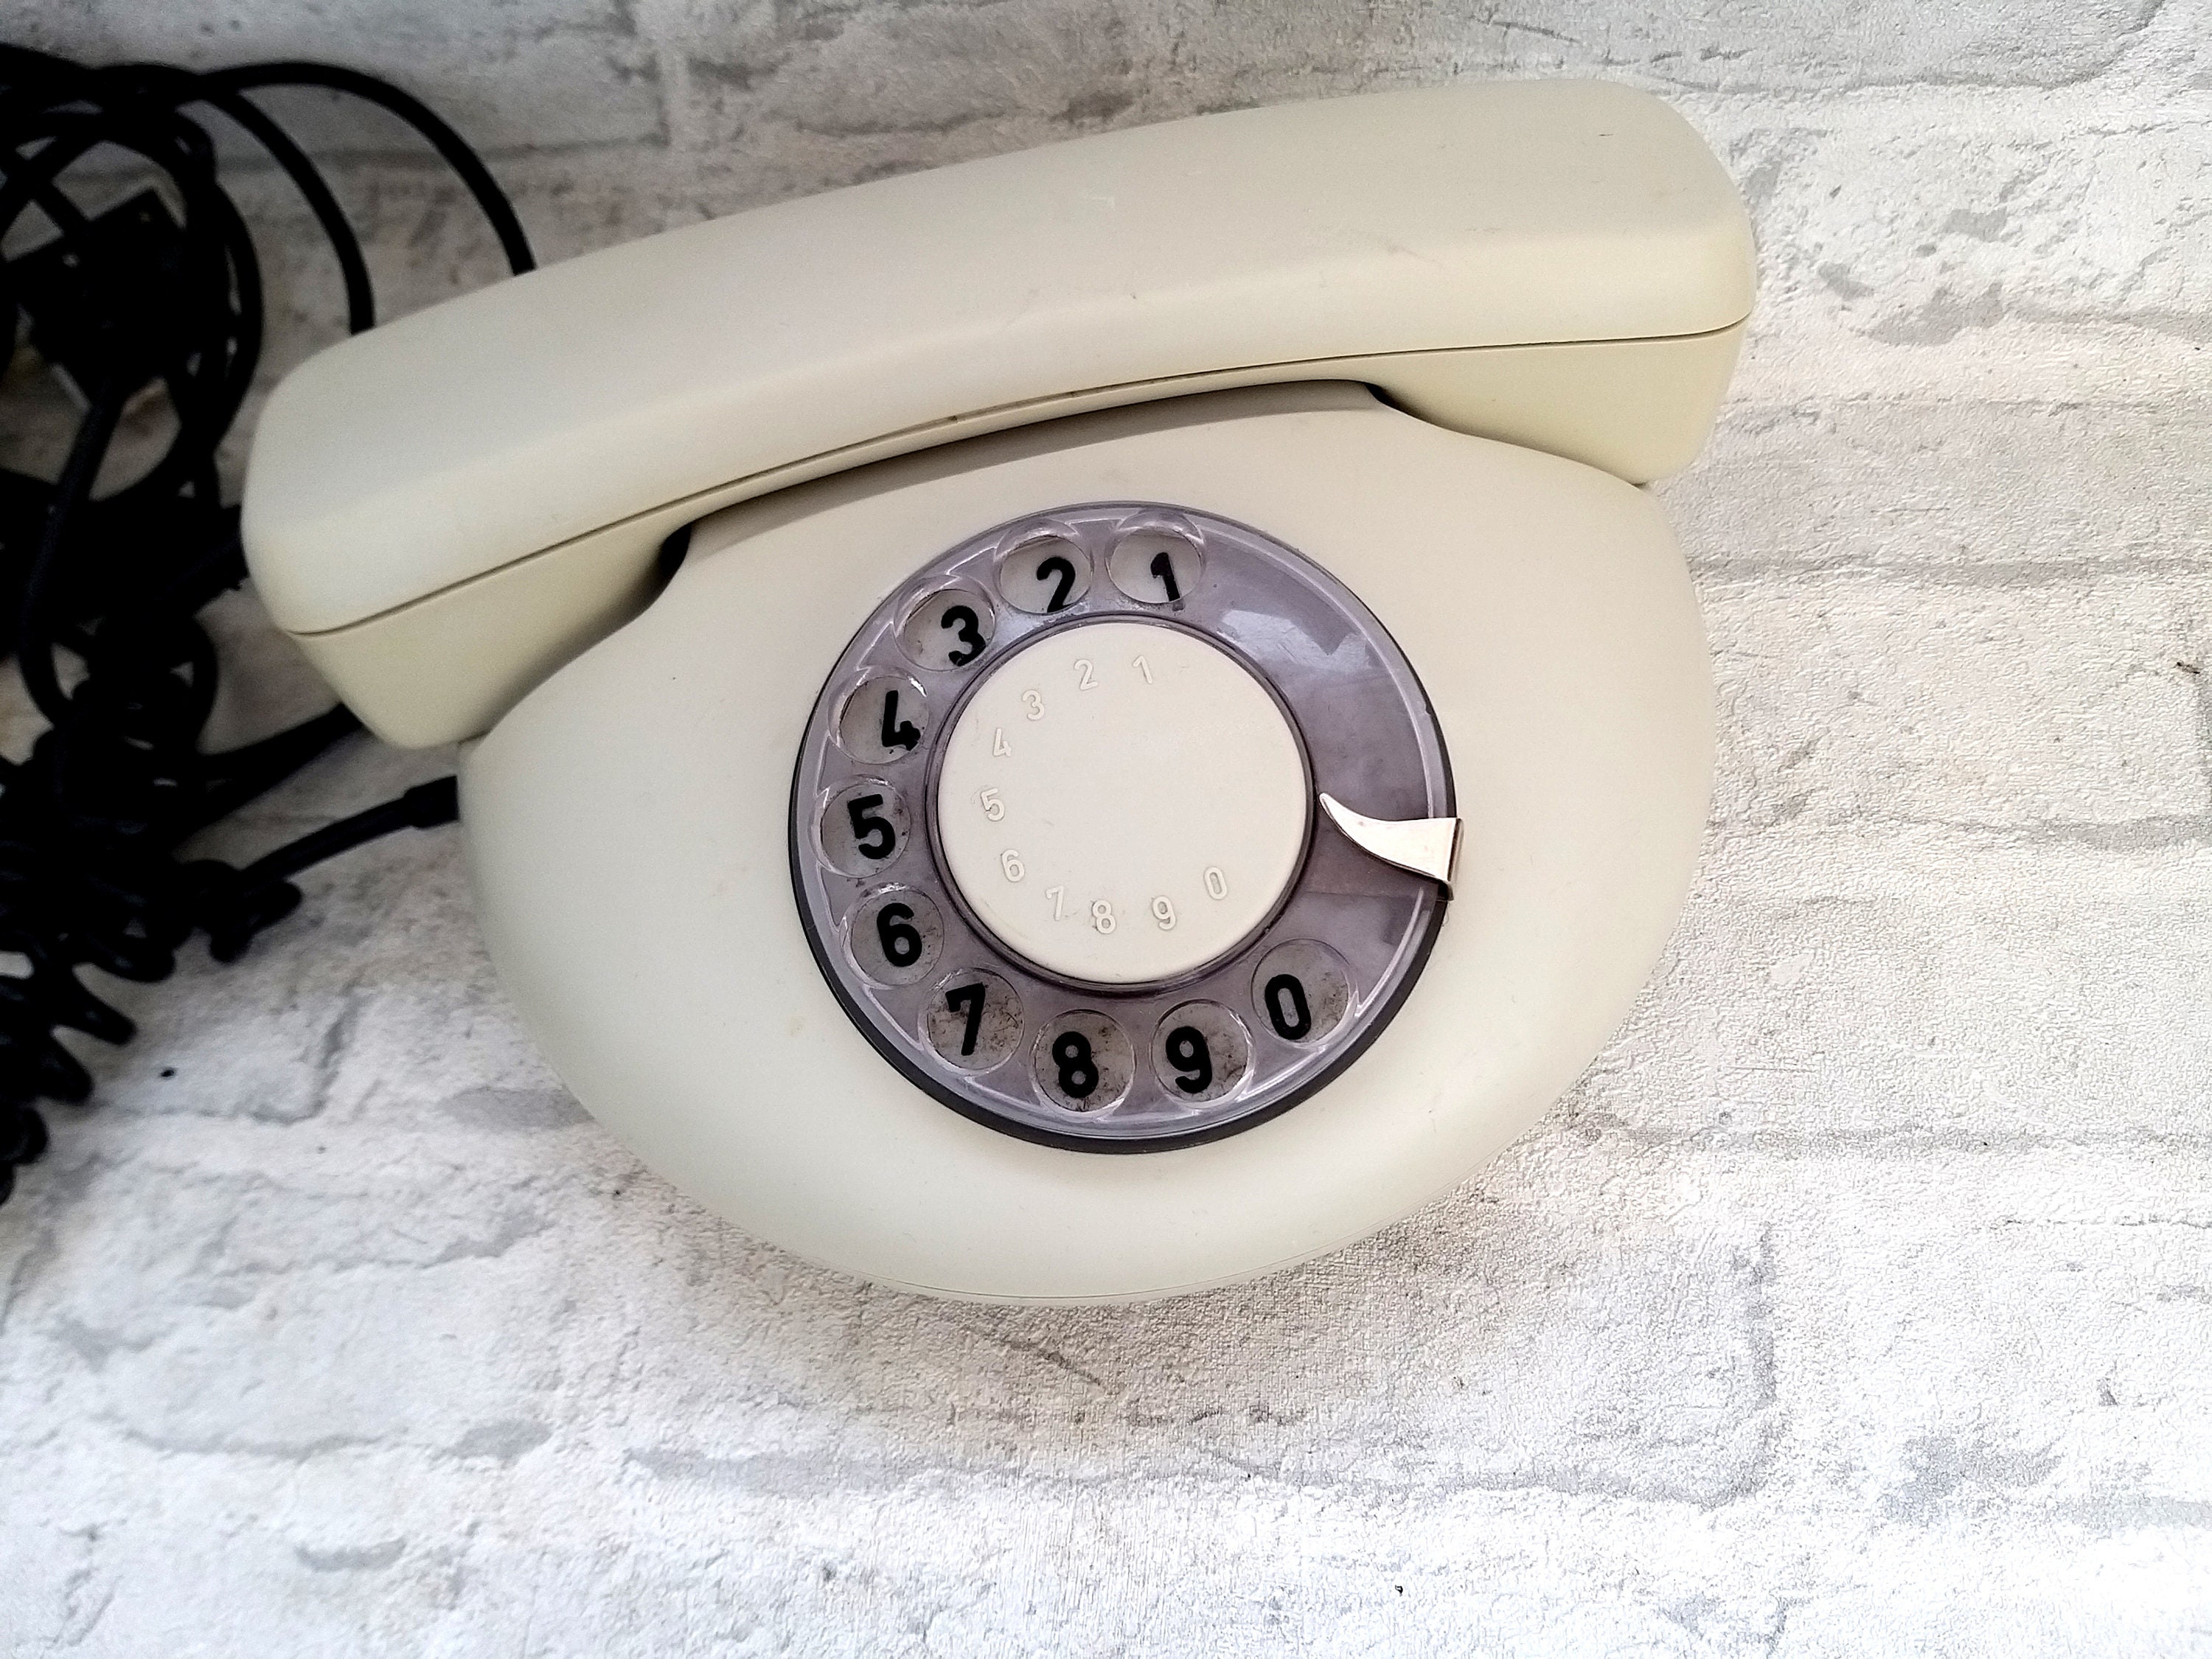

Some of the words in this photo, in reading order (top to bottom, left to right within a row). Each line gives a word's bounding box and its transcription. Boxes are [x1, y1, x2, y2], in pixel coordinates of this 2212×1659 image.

[1037, 557, 1077, 612] 2
[1150, 552, 1185, 610] 1
[941, 605, 987, 667] 3
[1074, 659, 1099, 689] 2
[1133, 656, 1153, 684] 1
[882, 691, 921, 751] 4
[1022, 689, 1045, 720] 3
[994, 728, 1011, 757] 4
[847, 794, 896, 859] 5
[981, 788, 1005, 821] 5
[1001, 849, 1025, 882] 6
[1203, 867, 1227, 899] 0
[1046, 886, 1065, 920] 7
[1093, 900, 1116, 933] 8
[1152, 896, 1175, 929] 9
[876, 902, 922, 967] 6
[945, 984, 986, 1056] 7
[1264, 974, 1311, 1040] 0
[1051, 1032, 1099, 1099] 8
[1166, 1026, 1213, 1094] 9
